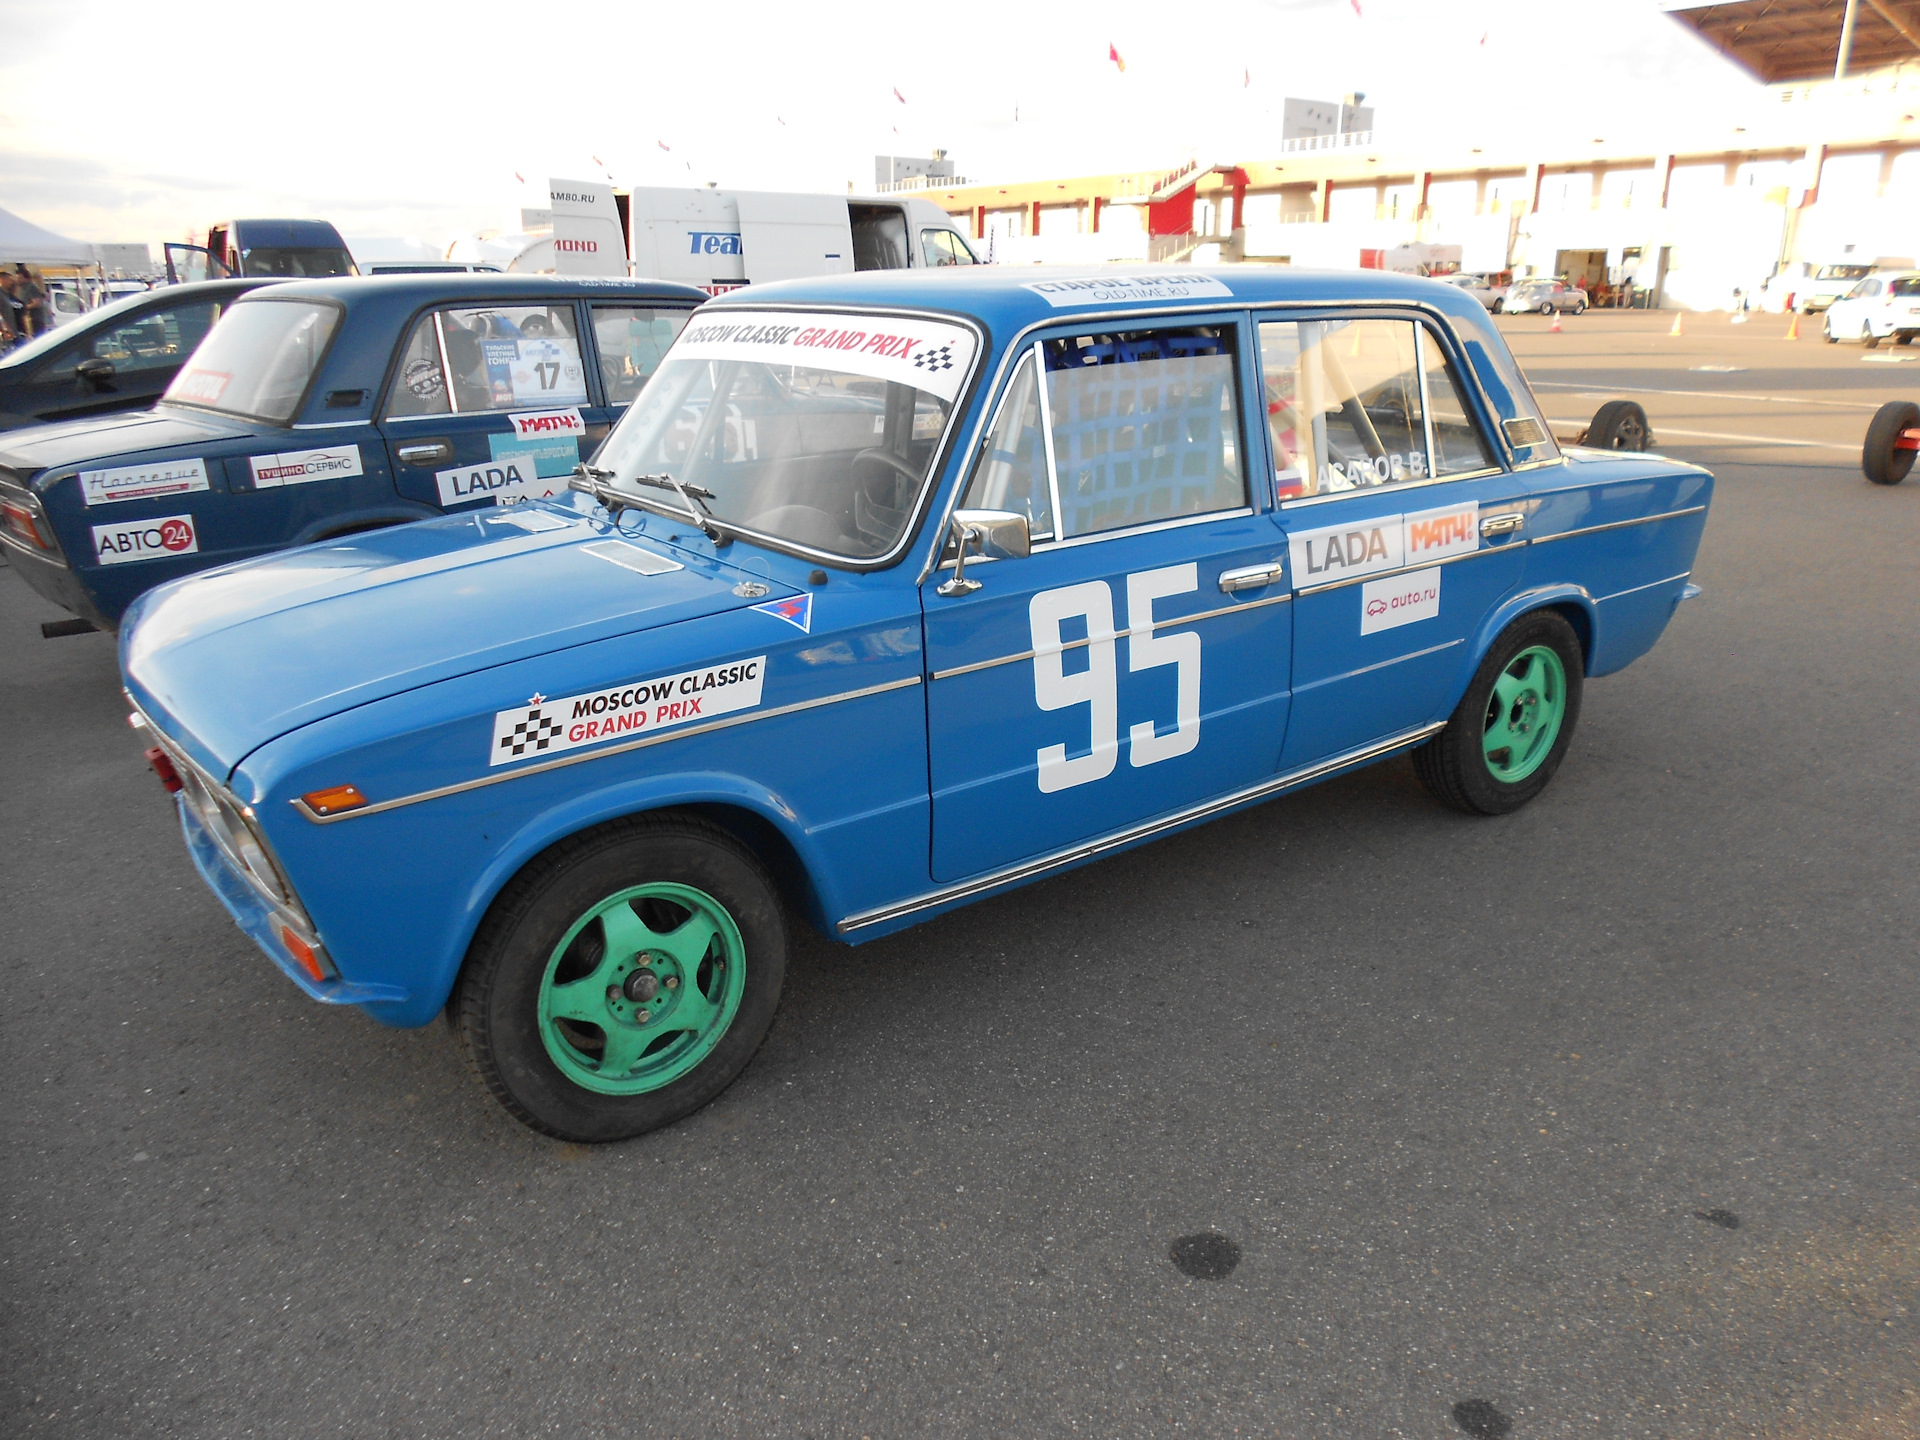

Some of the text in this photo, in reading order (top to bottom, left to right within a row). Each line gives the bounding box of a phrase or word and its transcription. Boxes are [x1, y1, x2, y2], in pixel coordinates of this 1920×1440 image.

[688, 232, 743, 255] Tea
[1093, 286, 1190, 300] OLD-TIME.RU
[681, 325, 922, 359] MOSCOW CLASSIC GRAND PRIX
[534, 362, 561, 390] 17
[518, 415, 580, 433] МАТЧ!
[452, 465, 524, 496] LADA
[1316, 451, 1429, 491] АСАНОВ В.
[1411, 512, 1474, 552] МАТЧ!
[1306, 527, 1389, 575] LADA
[1391, 587, 1436, 609] auto.ru
[572, 662, 758, 719] MOSCOW CLASSIC
[1029, 562, 1201, 793] 95
[568, 697, 703, 743] GRAND PRIX
